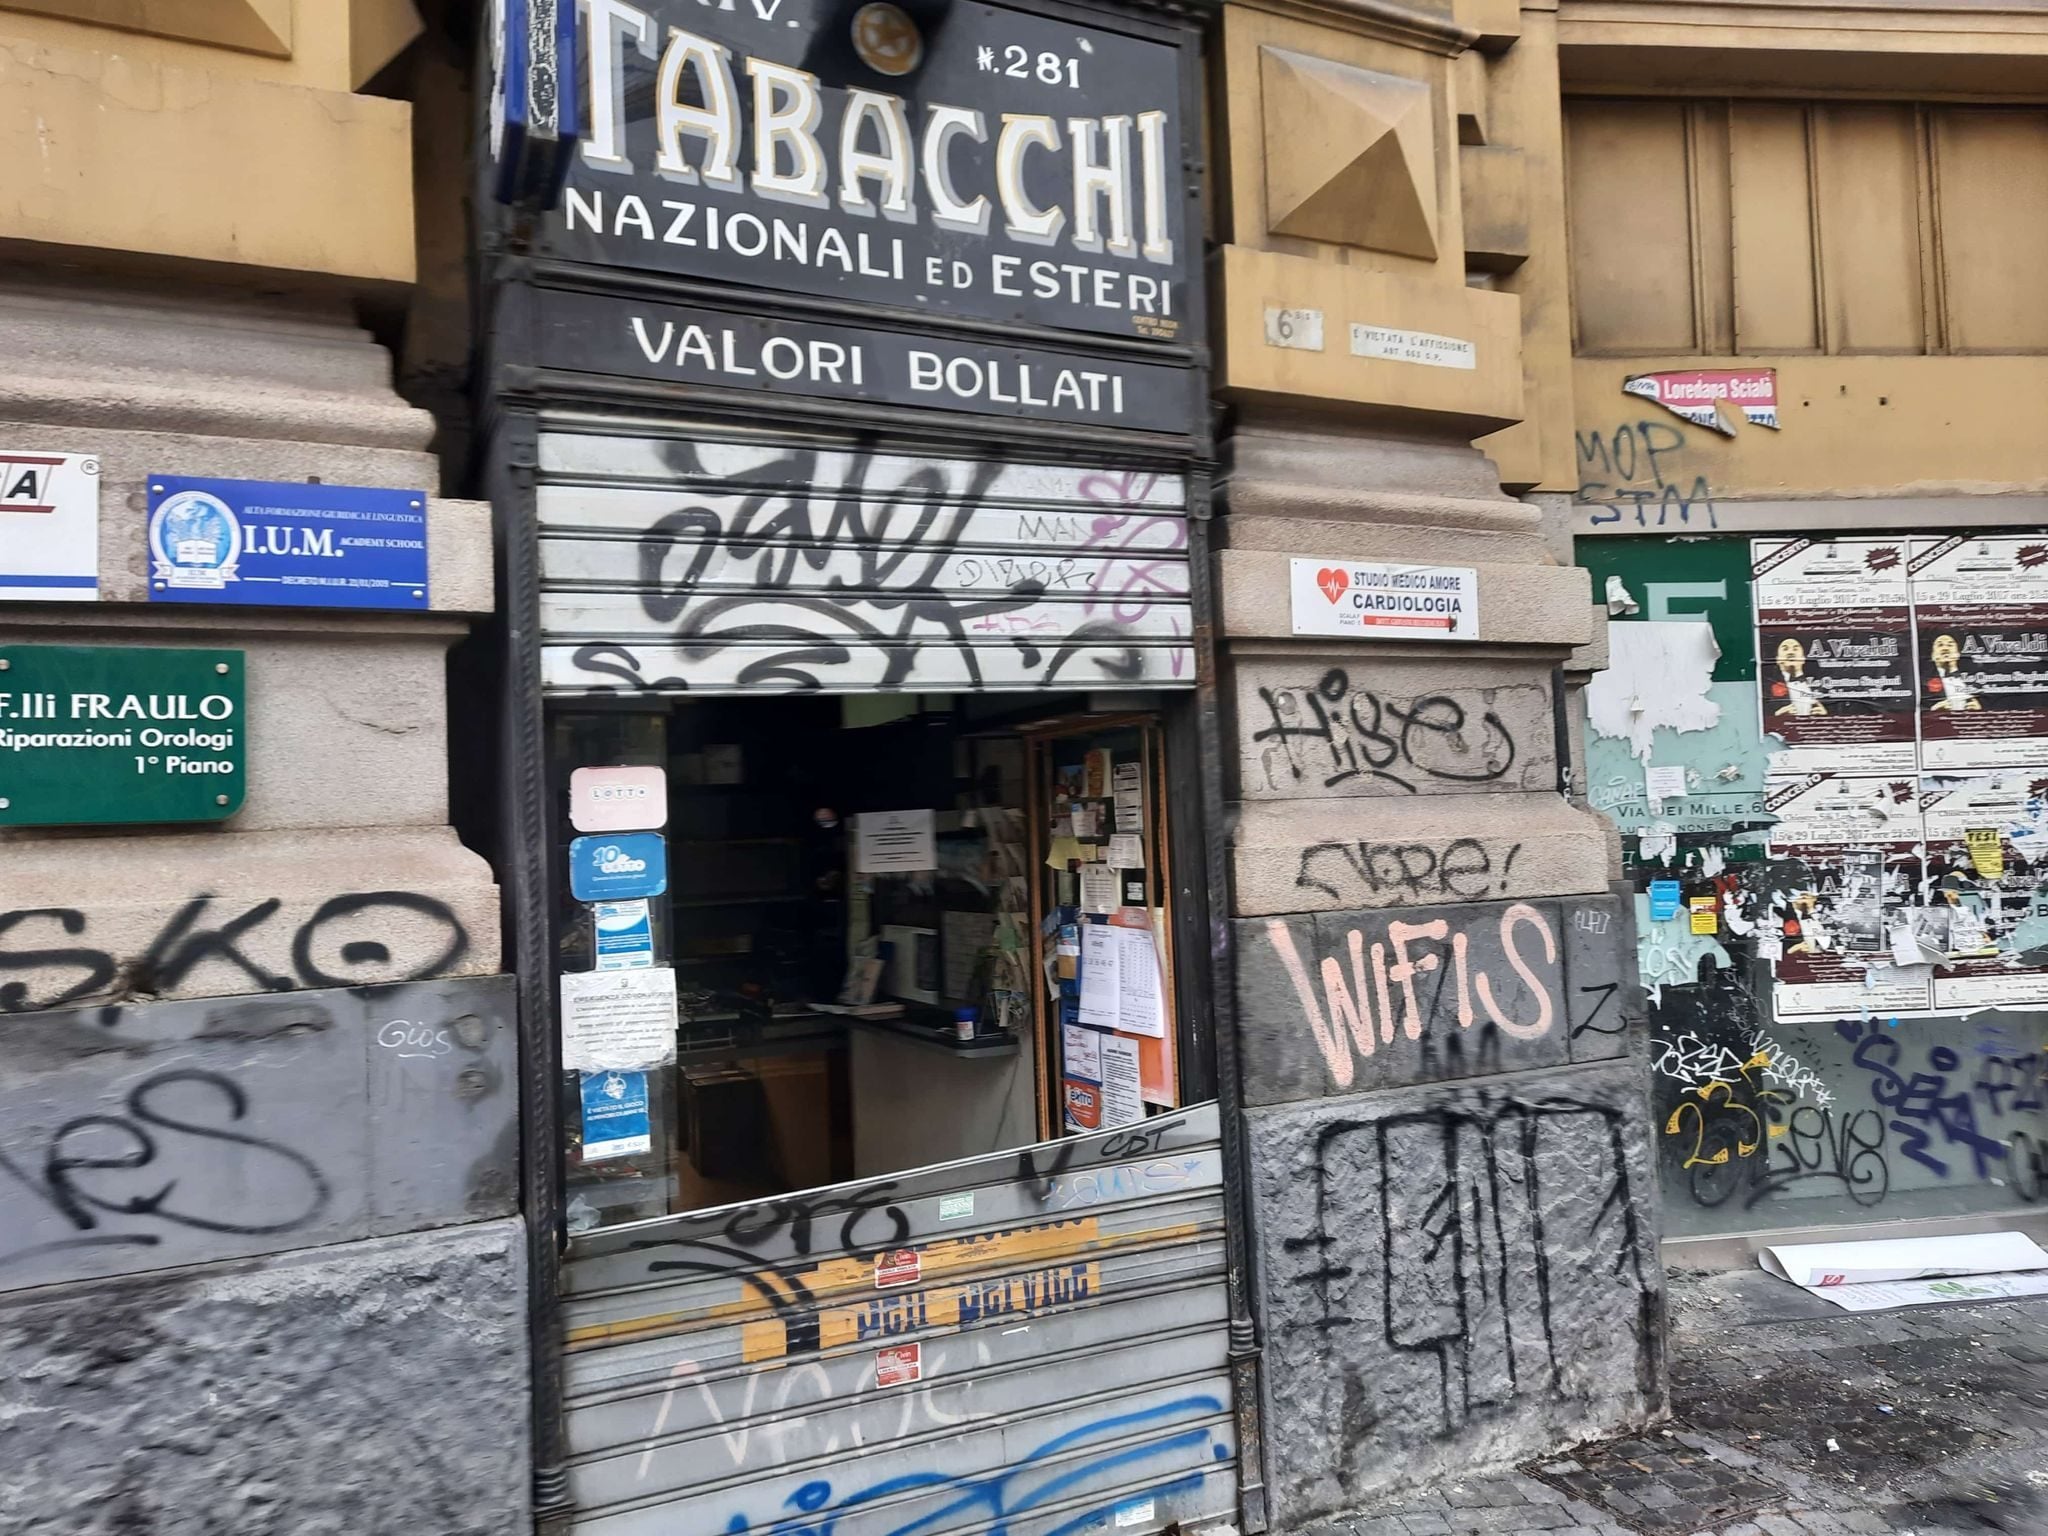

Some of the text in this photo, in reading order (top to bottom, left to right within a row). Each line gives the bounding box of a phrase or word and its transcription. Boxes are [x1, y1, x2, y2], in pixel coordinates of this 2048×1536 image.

[578, 0, 1174, 264] TABACCHI
[565, 187, 1173, 316] NAZIONALI ED ESTERI
[1277, 309, 1294, 339] 6
[1364, 331, 1403, 344] VIETATA
[631, 316, 1124, 414] VALORI BOLLATI
[1664, 379, 1727, 399] Loredana
[243, 525, 424, 557] I.U.M. ACADEMY SCHOOL
[1753, 538, 1810, 575] CONCERTO
[1354, 571, 1461, 590] STUDIO MEDICO AMORE
[1353, 594, 1462, 613] CARDIOLOGIA
[1800, 594, 1832, 607] Luglio
[1834, 594, 1858, 604] 2017
[0, 693, 233, 720] F.lli FRAULO
[0, 728, 233, 751] Riparazioni Orologi
[134, 757, 233, 775] 1° Piano
[1765, 773, 1822, 811] CONCERTO
[1617, 806, 1645, 818] VIA
[1811, 830, 1843, 843] Luglio
[1967, 832, 1997, 842] TESI
